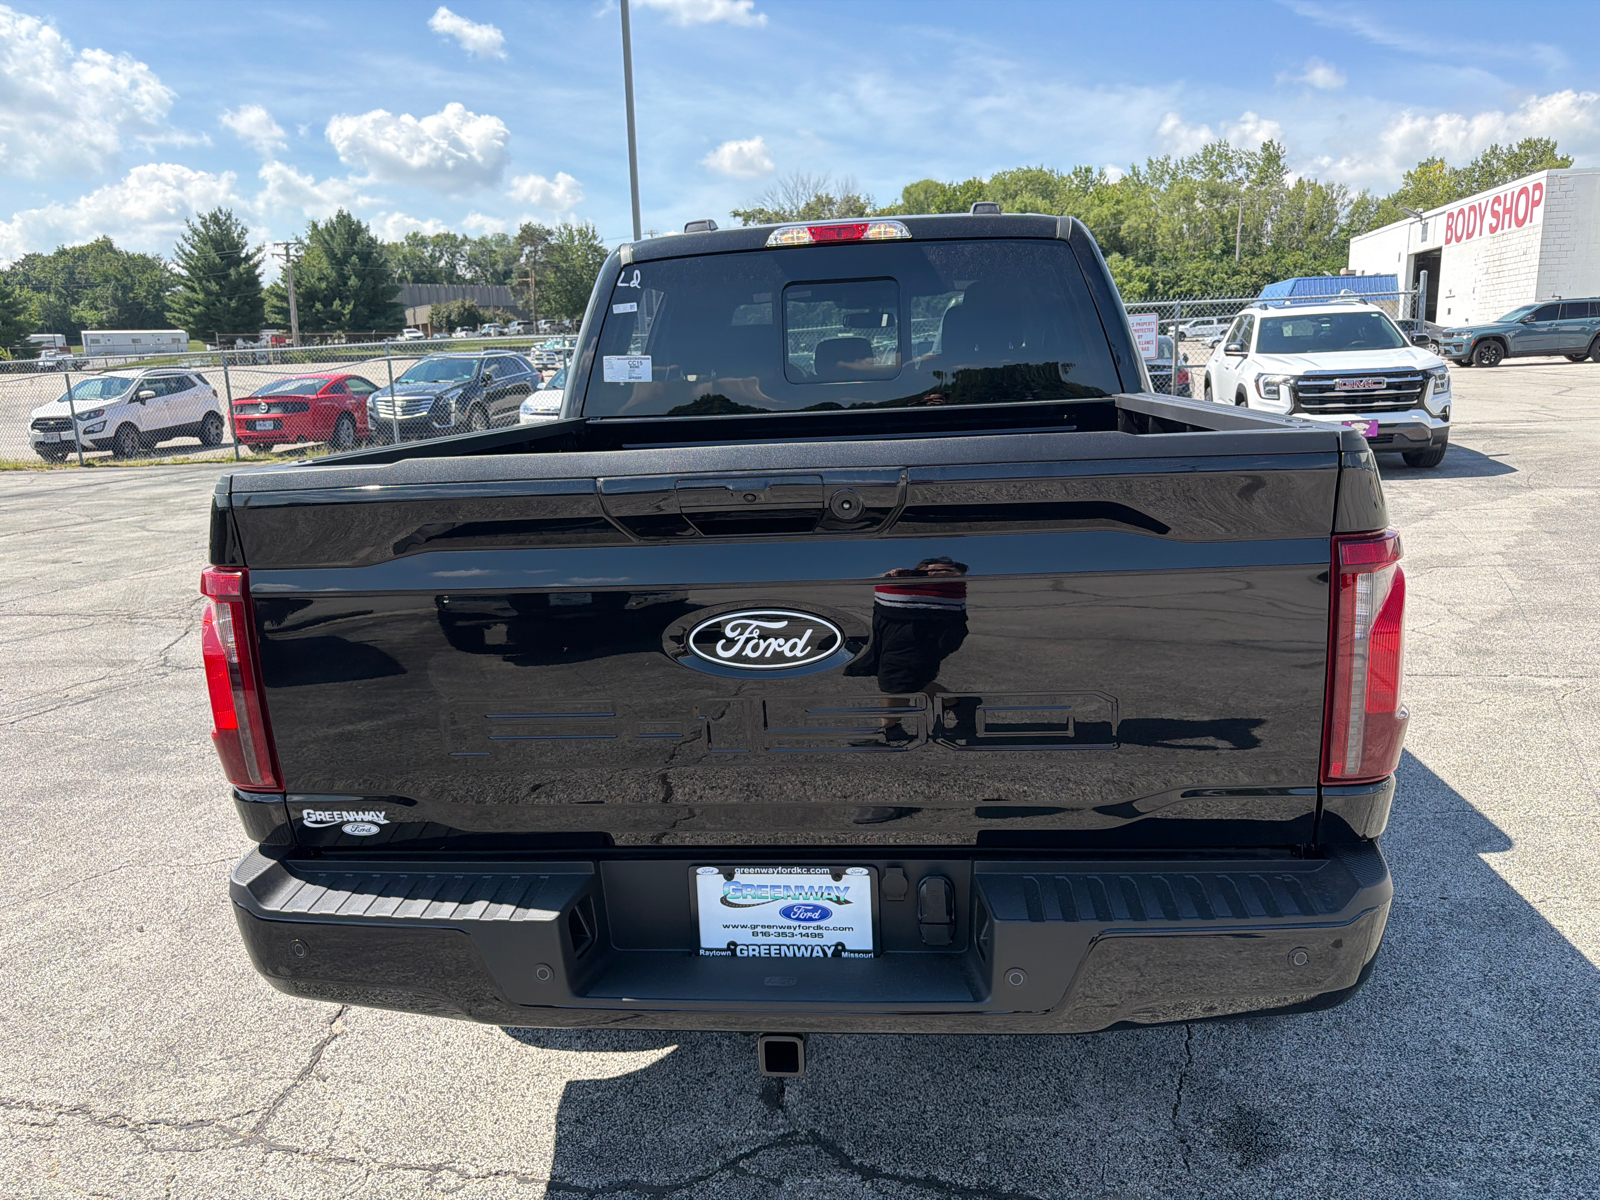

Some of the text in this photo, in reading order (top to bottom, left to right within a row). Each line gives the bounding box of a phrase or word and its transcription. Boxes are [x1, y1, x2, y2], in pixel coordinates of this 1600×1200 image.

[1445, 182, 1543, 245] BODY SHOP
[1340, 379, 1383, 388] GMC
[715, 619, 813, 658] Ford
[302, 809, 386, 822] GREENWAY
[350, 824, 373, 834] Ford
[734, 866, 830, 875] greenwayfordkc.com
[722, 881, 851, 902] GREENWAY
[790, 906, 821, 920] Ford
[722, 923, 854, 932] www.greenwayfordkc.com
[751, 931, 824, 939] 816-353-1495
[700, 944, 874, 959] Raytown GREENWAY Missouri
